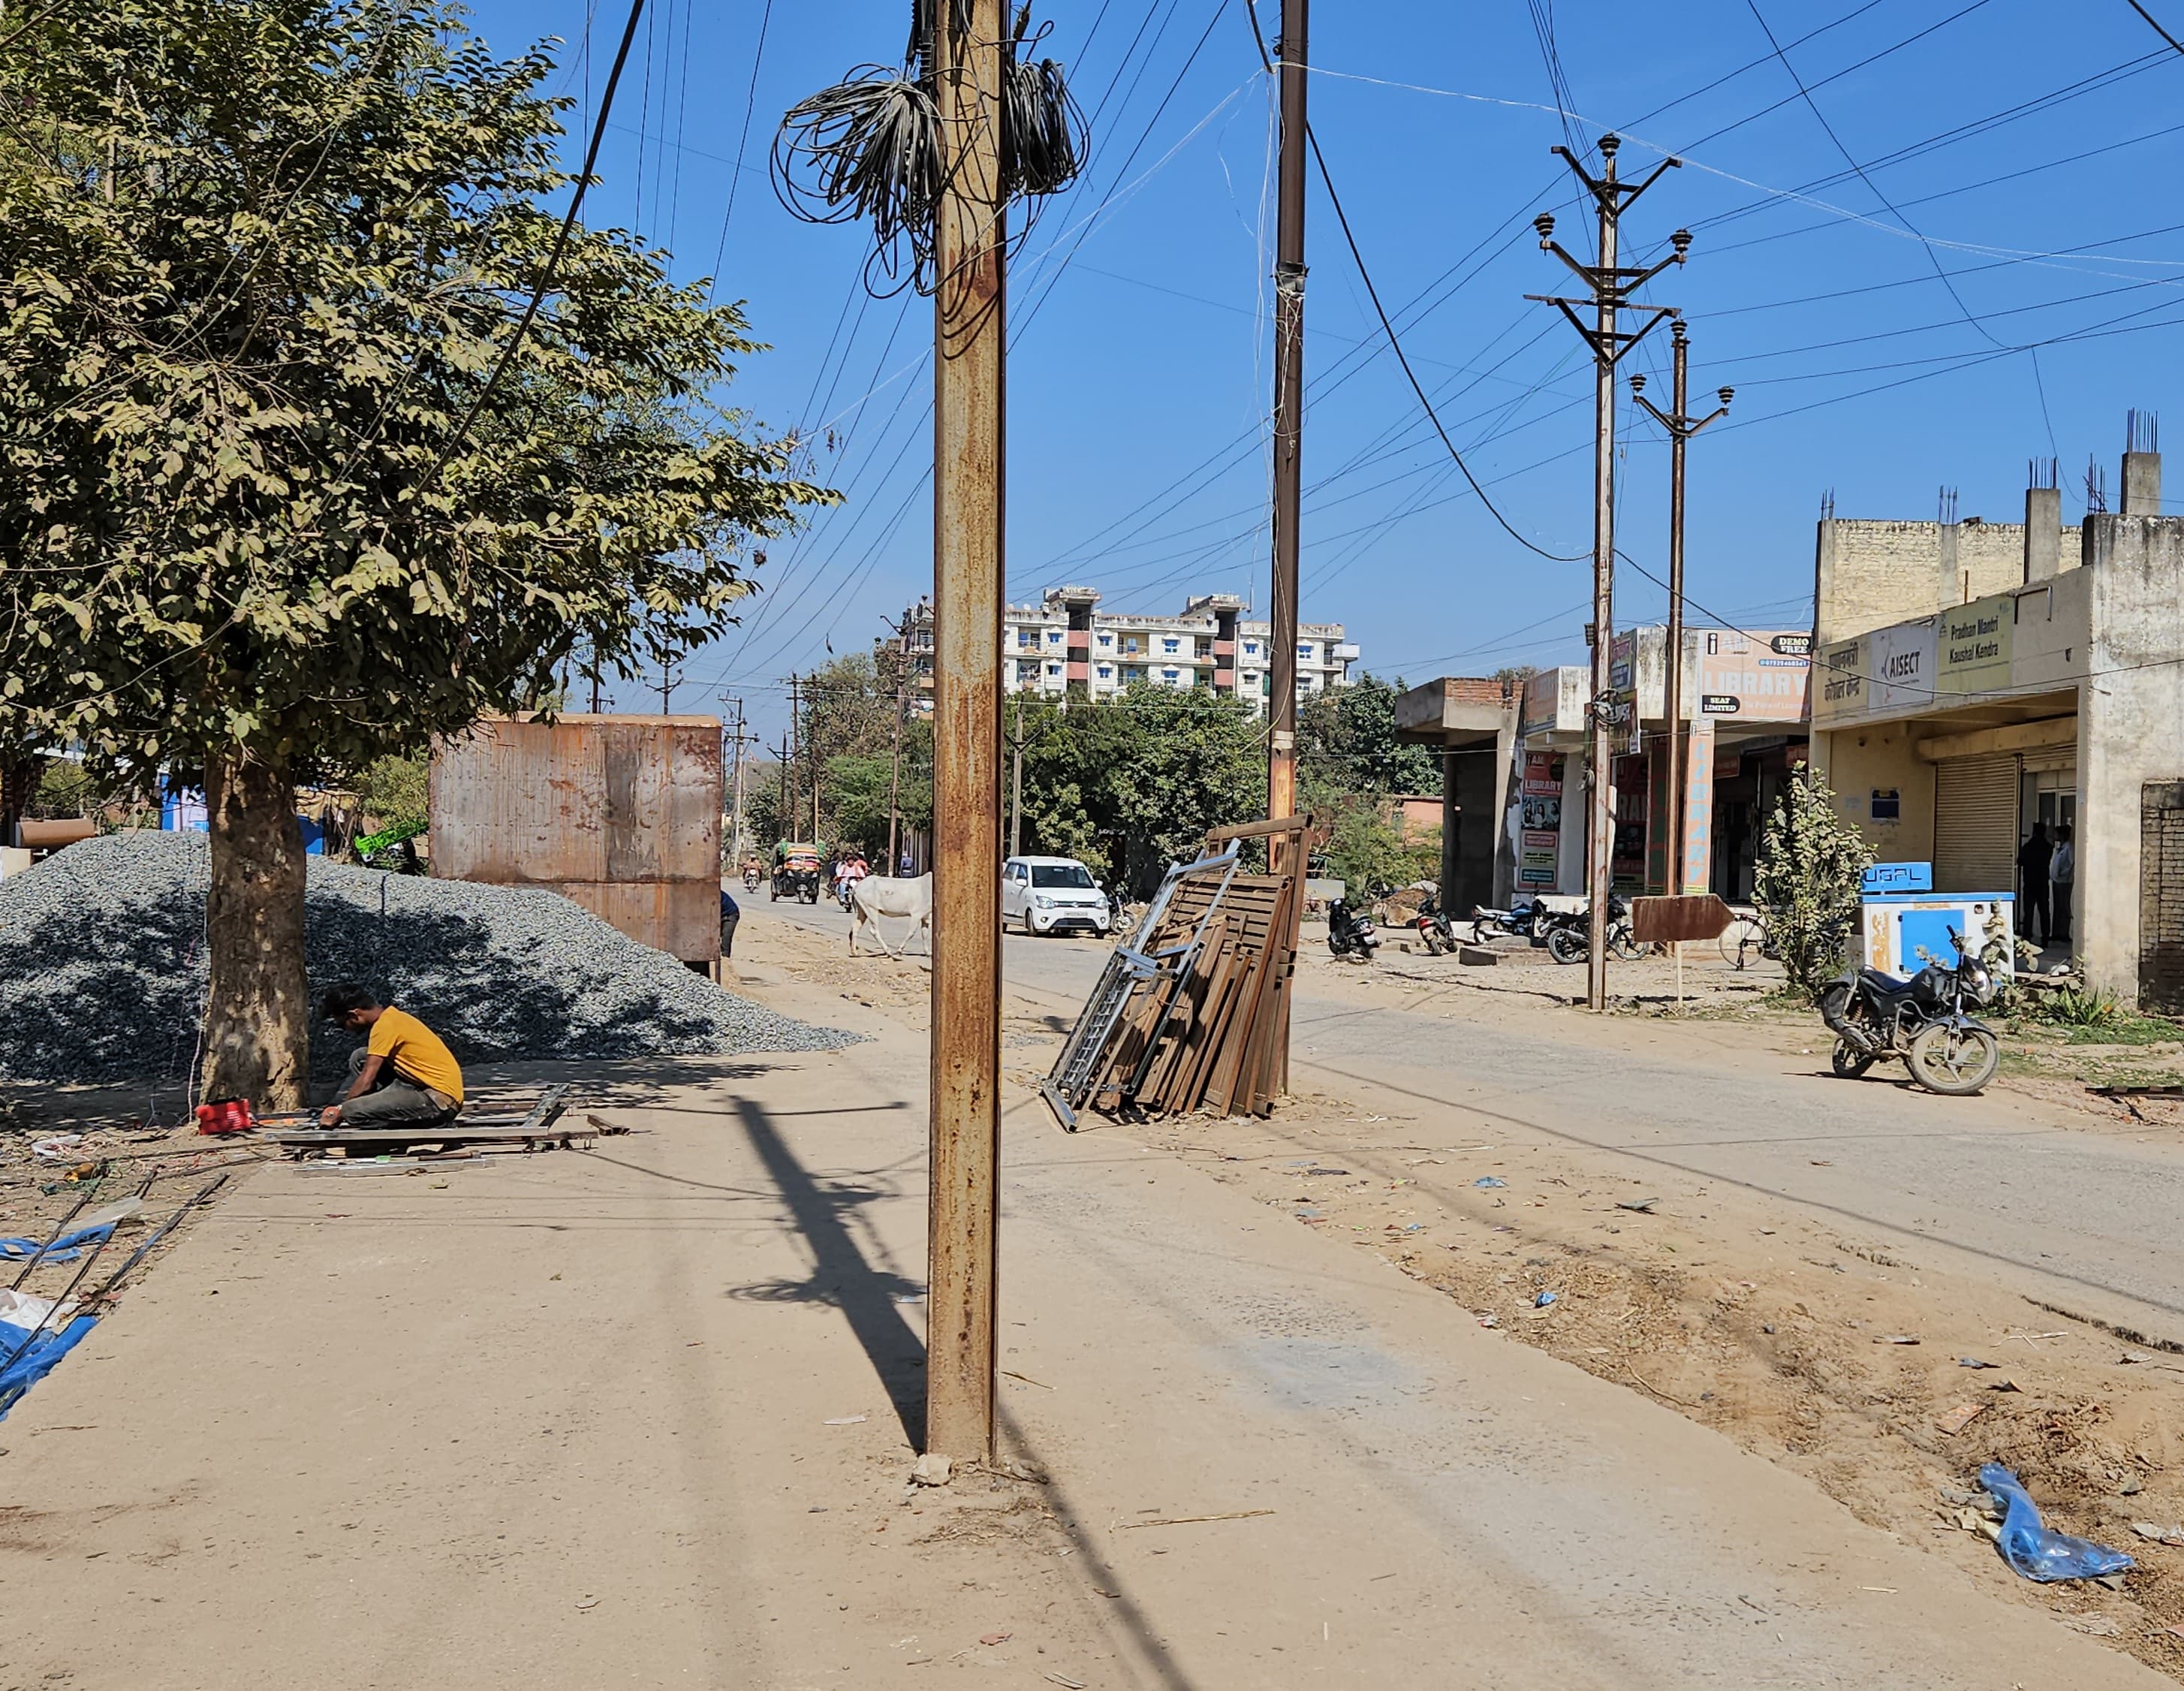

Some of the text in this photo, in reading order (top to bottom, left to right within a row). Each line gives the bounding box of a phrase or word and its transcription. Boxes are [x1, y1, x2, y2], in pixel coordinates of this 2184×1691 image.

[1951, 615, 1999, 641] Pradhan Mantri
[1779, 638, 1809, 646] DEMO
[1949, 641, 1999, 664] Kaushal Kendra
[1889, 651, 1920, 679] AISECT
[1704, 671, 1808, 696] LIBRARY
[1704, 704, 1737, 712] LIMITED
[1525, 779, 1562, 791] LIBRARY
[1689, 743, 1707, 882] LIBRARY
[1863, 869, 1922, 882] UGPL
